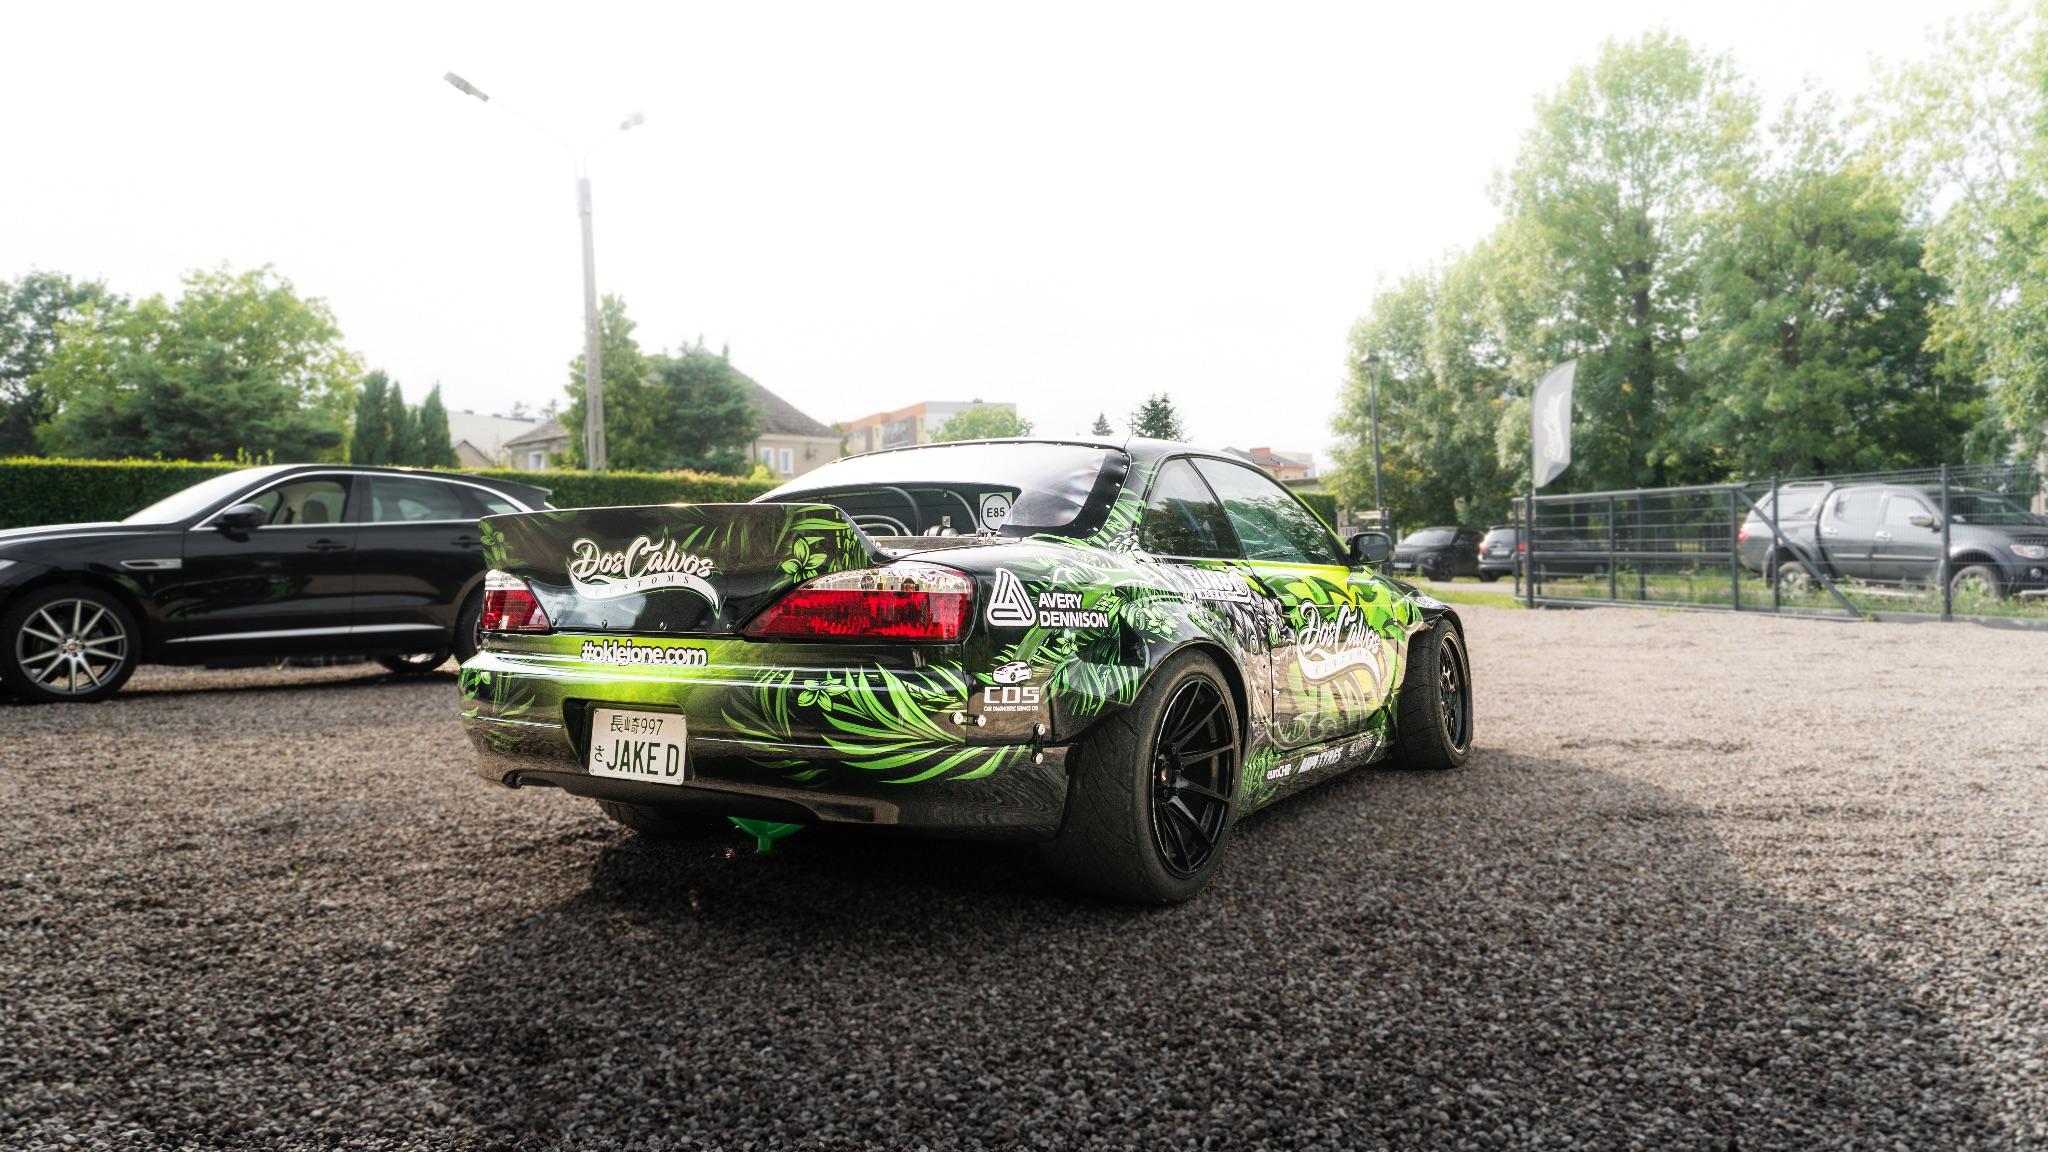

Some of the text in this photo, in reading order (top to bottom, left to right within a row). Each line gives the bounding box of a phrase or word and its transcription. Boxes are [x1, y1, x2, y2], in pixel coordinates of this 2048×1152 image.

[987, 508, 1005, 517] E85
[1039, 592, 1082, 609] AVERY
[1040, 611, 1109, 628] DENNISON
[581, 639, 707, 666] #oklejone.com
[983, 686, 1040, 704] CDS
[606, 739, 680, 777] JAKE D
